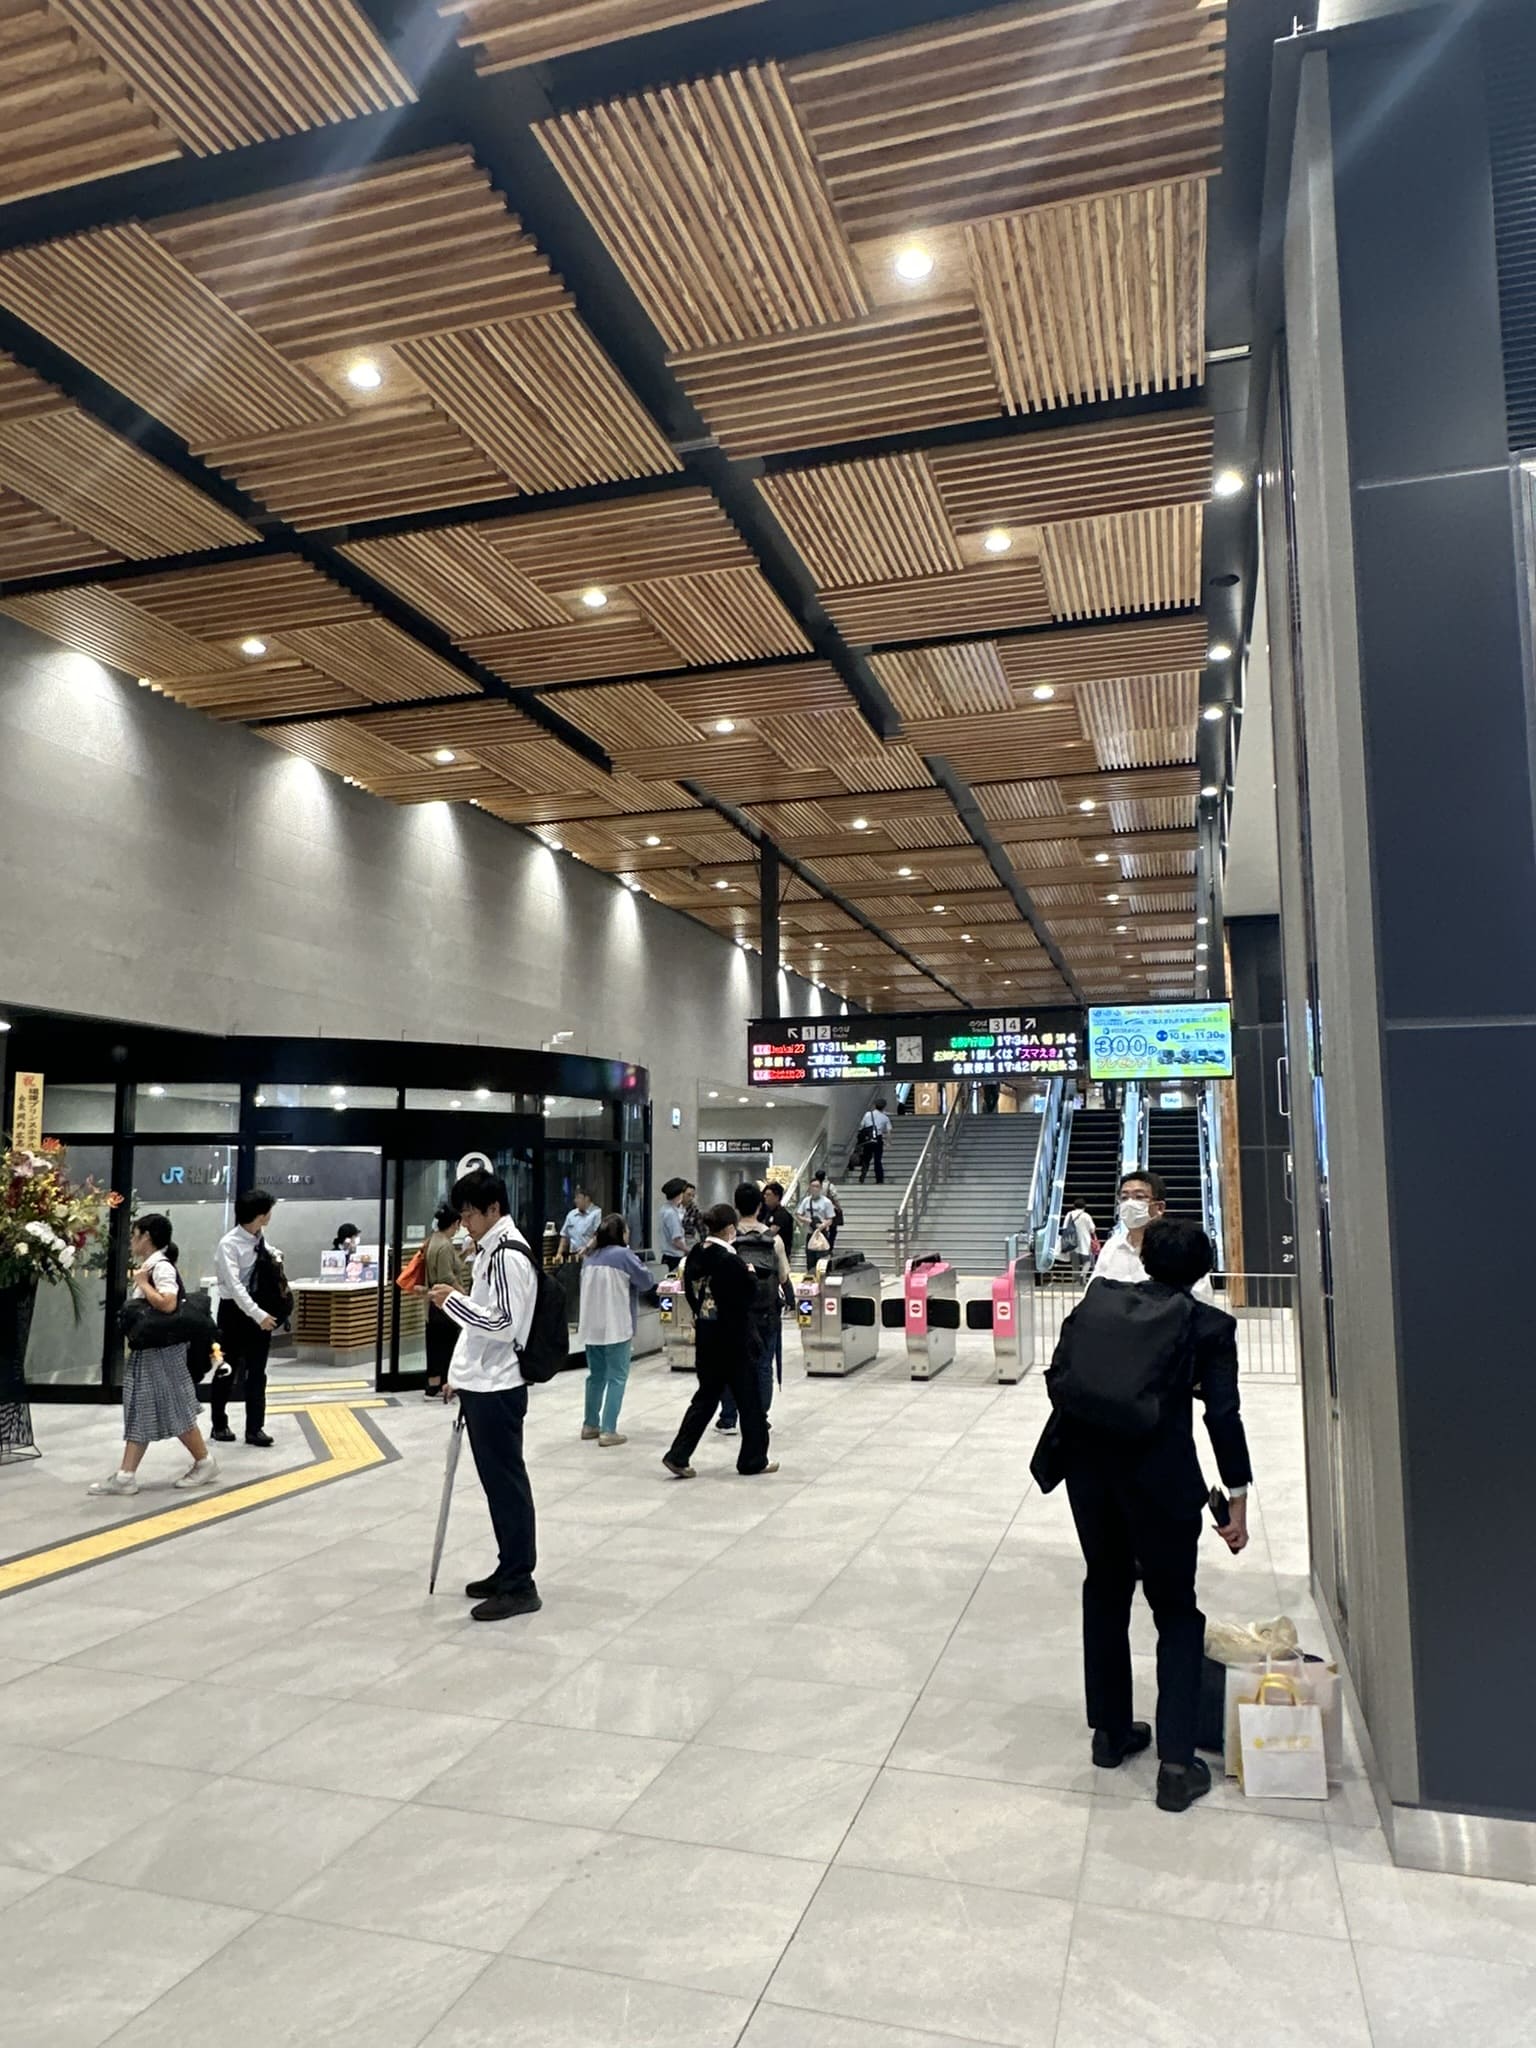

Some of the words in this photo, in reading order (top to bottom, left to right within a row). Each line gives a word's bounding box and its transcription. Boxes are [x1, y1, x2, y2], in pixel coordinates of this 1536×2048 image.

[812, 1042, 842, 1054] 17:31
[812, 1067, 843, 1079] 17:37
[921, 1094, 931, 1107] 2
[161, 1166, 185, 1184] JR
